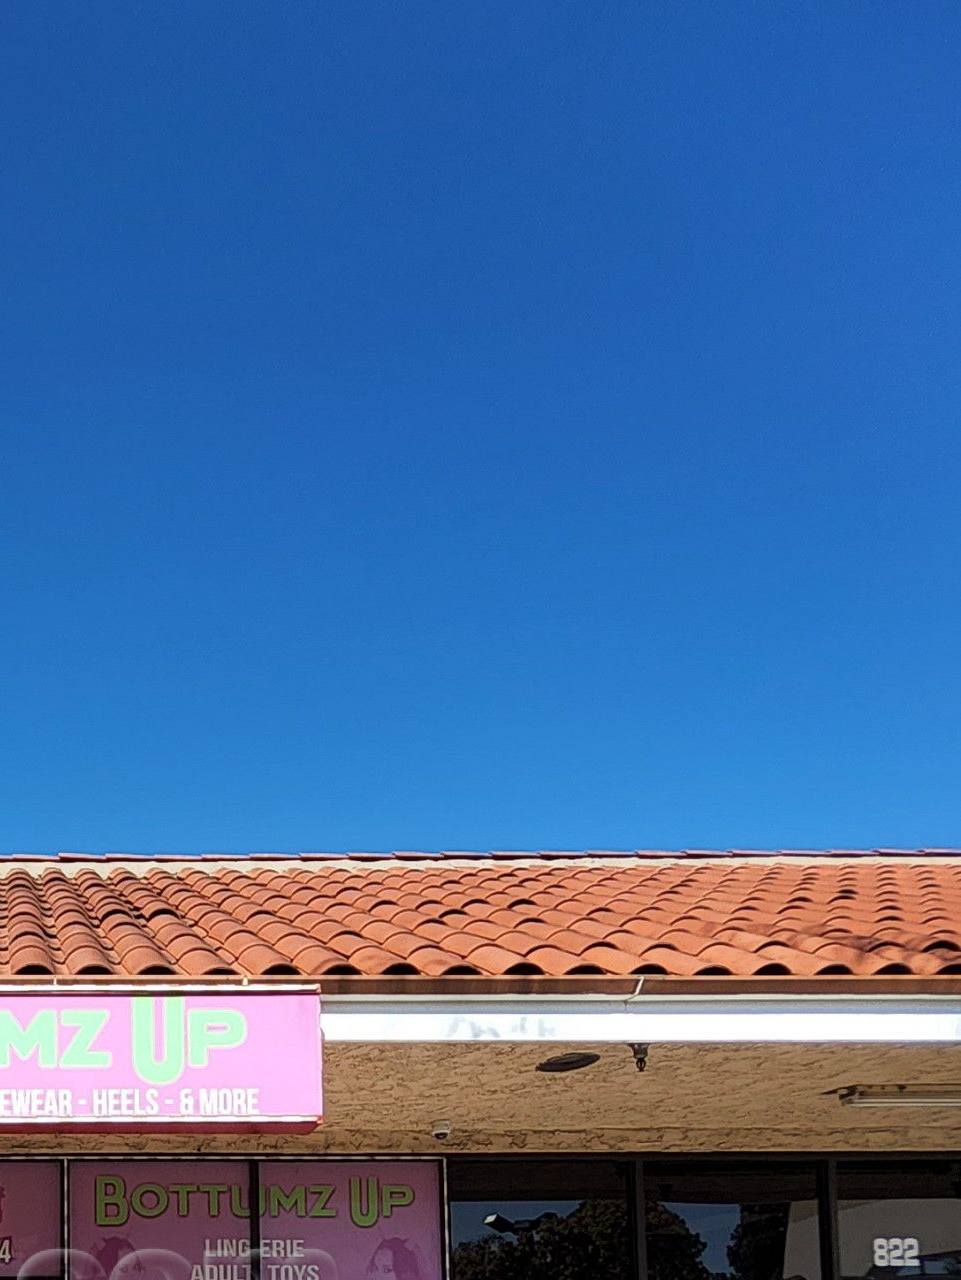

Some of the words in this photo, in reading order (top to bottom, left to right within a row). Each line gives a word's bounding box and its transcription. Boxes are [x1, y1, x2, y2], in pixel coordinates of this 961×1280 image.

[93, 1088, 159, 1116] HEELS
[179, 1088, 194, 1115] &
[199, 1088, 260, 1115] MORE
[204, 1239, 305, 1258] LINGERIE
[873, 1238, 921, 1267] 822
